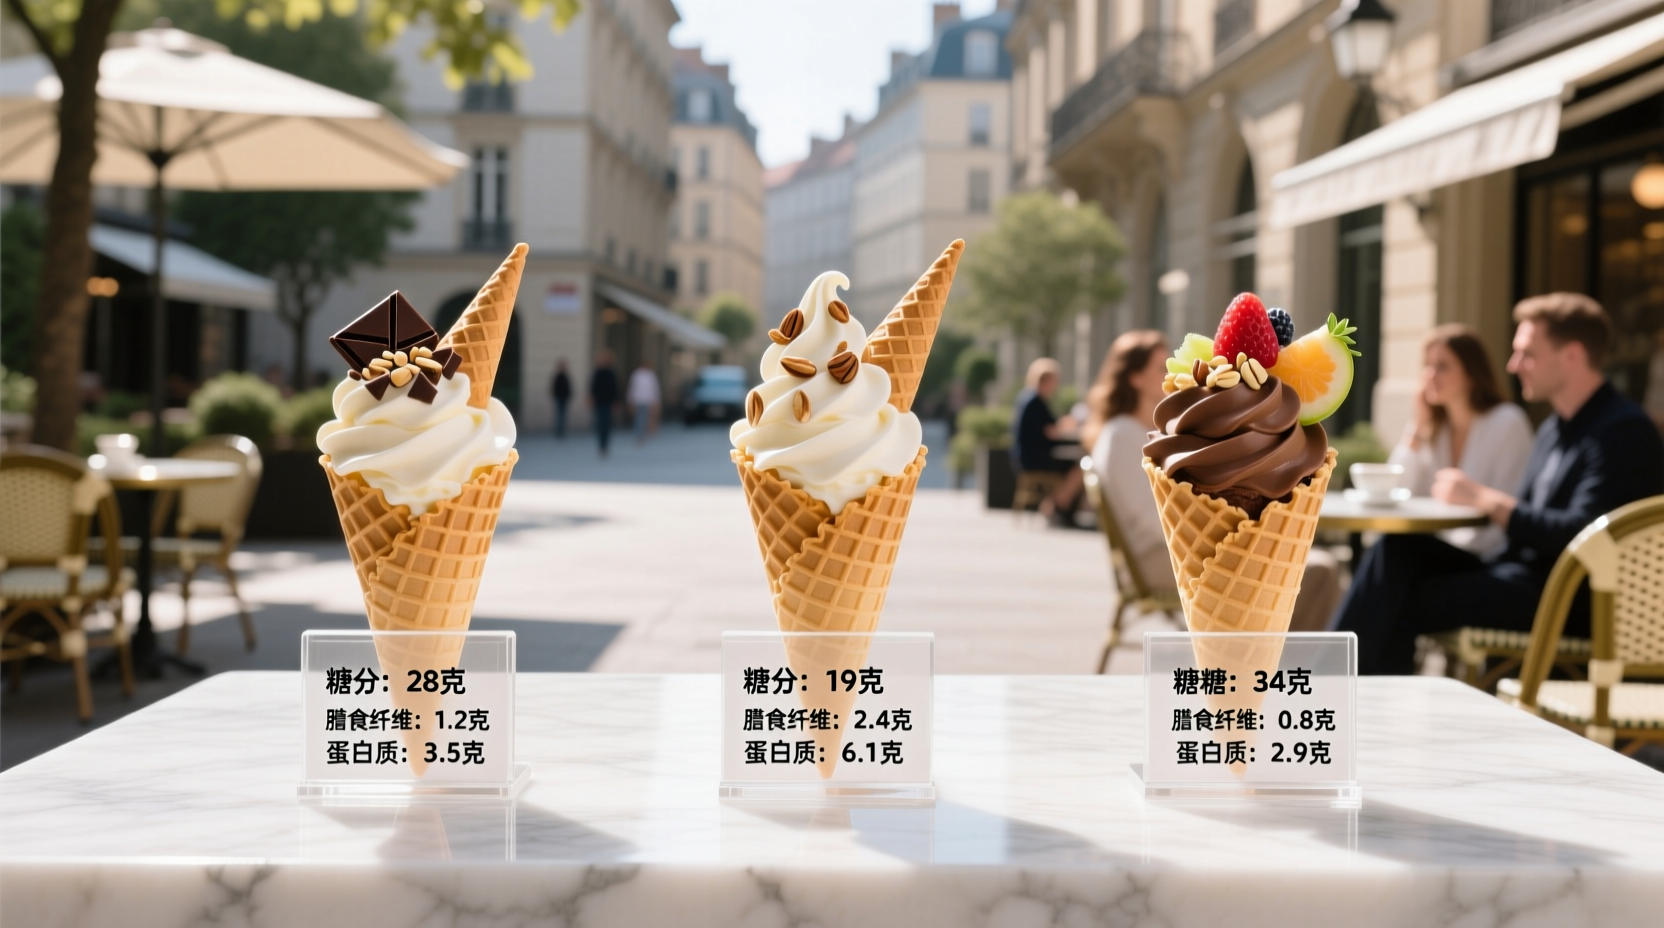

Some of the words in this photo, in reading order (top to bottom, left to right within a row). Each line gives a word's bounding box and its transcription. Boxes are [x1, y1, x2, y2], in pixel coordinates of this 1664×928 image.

[325, 666, 466, 696] 糖分：28克
[743, 666, 884, 695] 糖分：19克
[1173, 666, 1313, 696] 糖糖：34克
[326, 739, 485, 765] 蛋白质：3.5克
[744, 739, 904, 765] 蛋白质：6.1克
[1176, 740, 1332, 765] 蛋白质：2.9克
